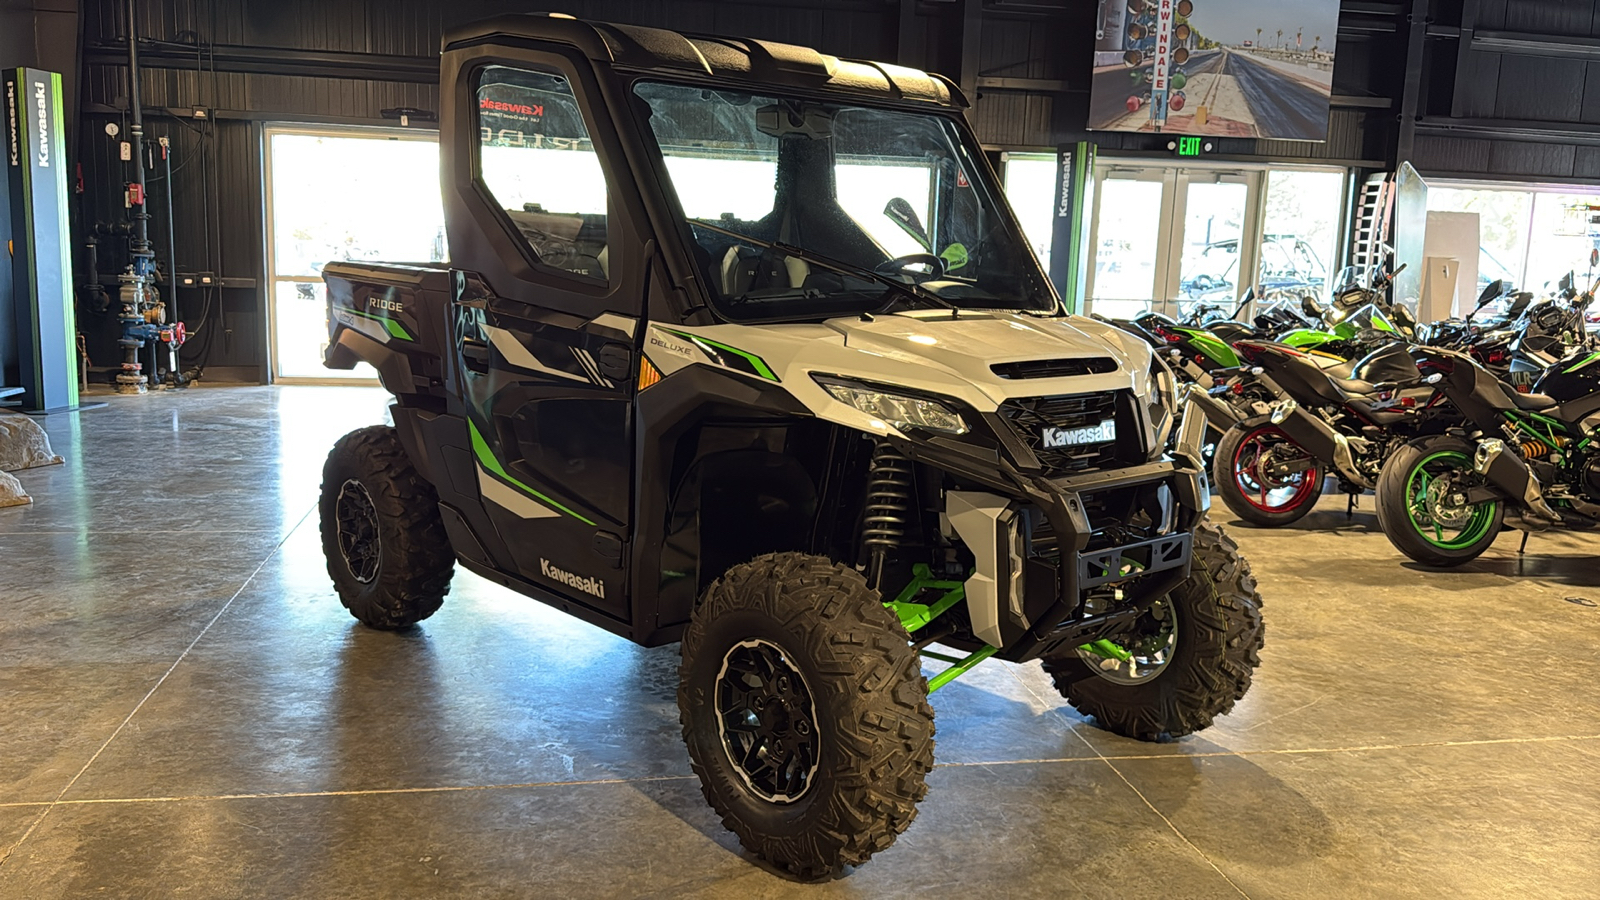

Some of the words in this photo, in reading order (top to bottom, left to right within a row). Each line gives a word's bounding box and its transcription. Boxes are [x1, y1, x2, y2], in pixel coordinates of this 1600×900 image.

[7, 81, 18, 166] Kawasaki
[35, 82, 49, 167] Kawasaki
[1179, 137, 1201, 156] EXIT
[1058, 151, 1072, 217] Kawasaki
[369, 297, 403, 312] RIDGE
[651, 338, 692, 355] DELUXE
[1511, 372, 1532, 385] KLR
[1043, 420, 1116, 448] Kawasaki
[540, 557, 605, 599] Kawasaki
